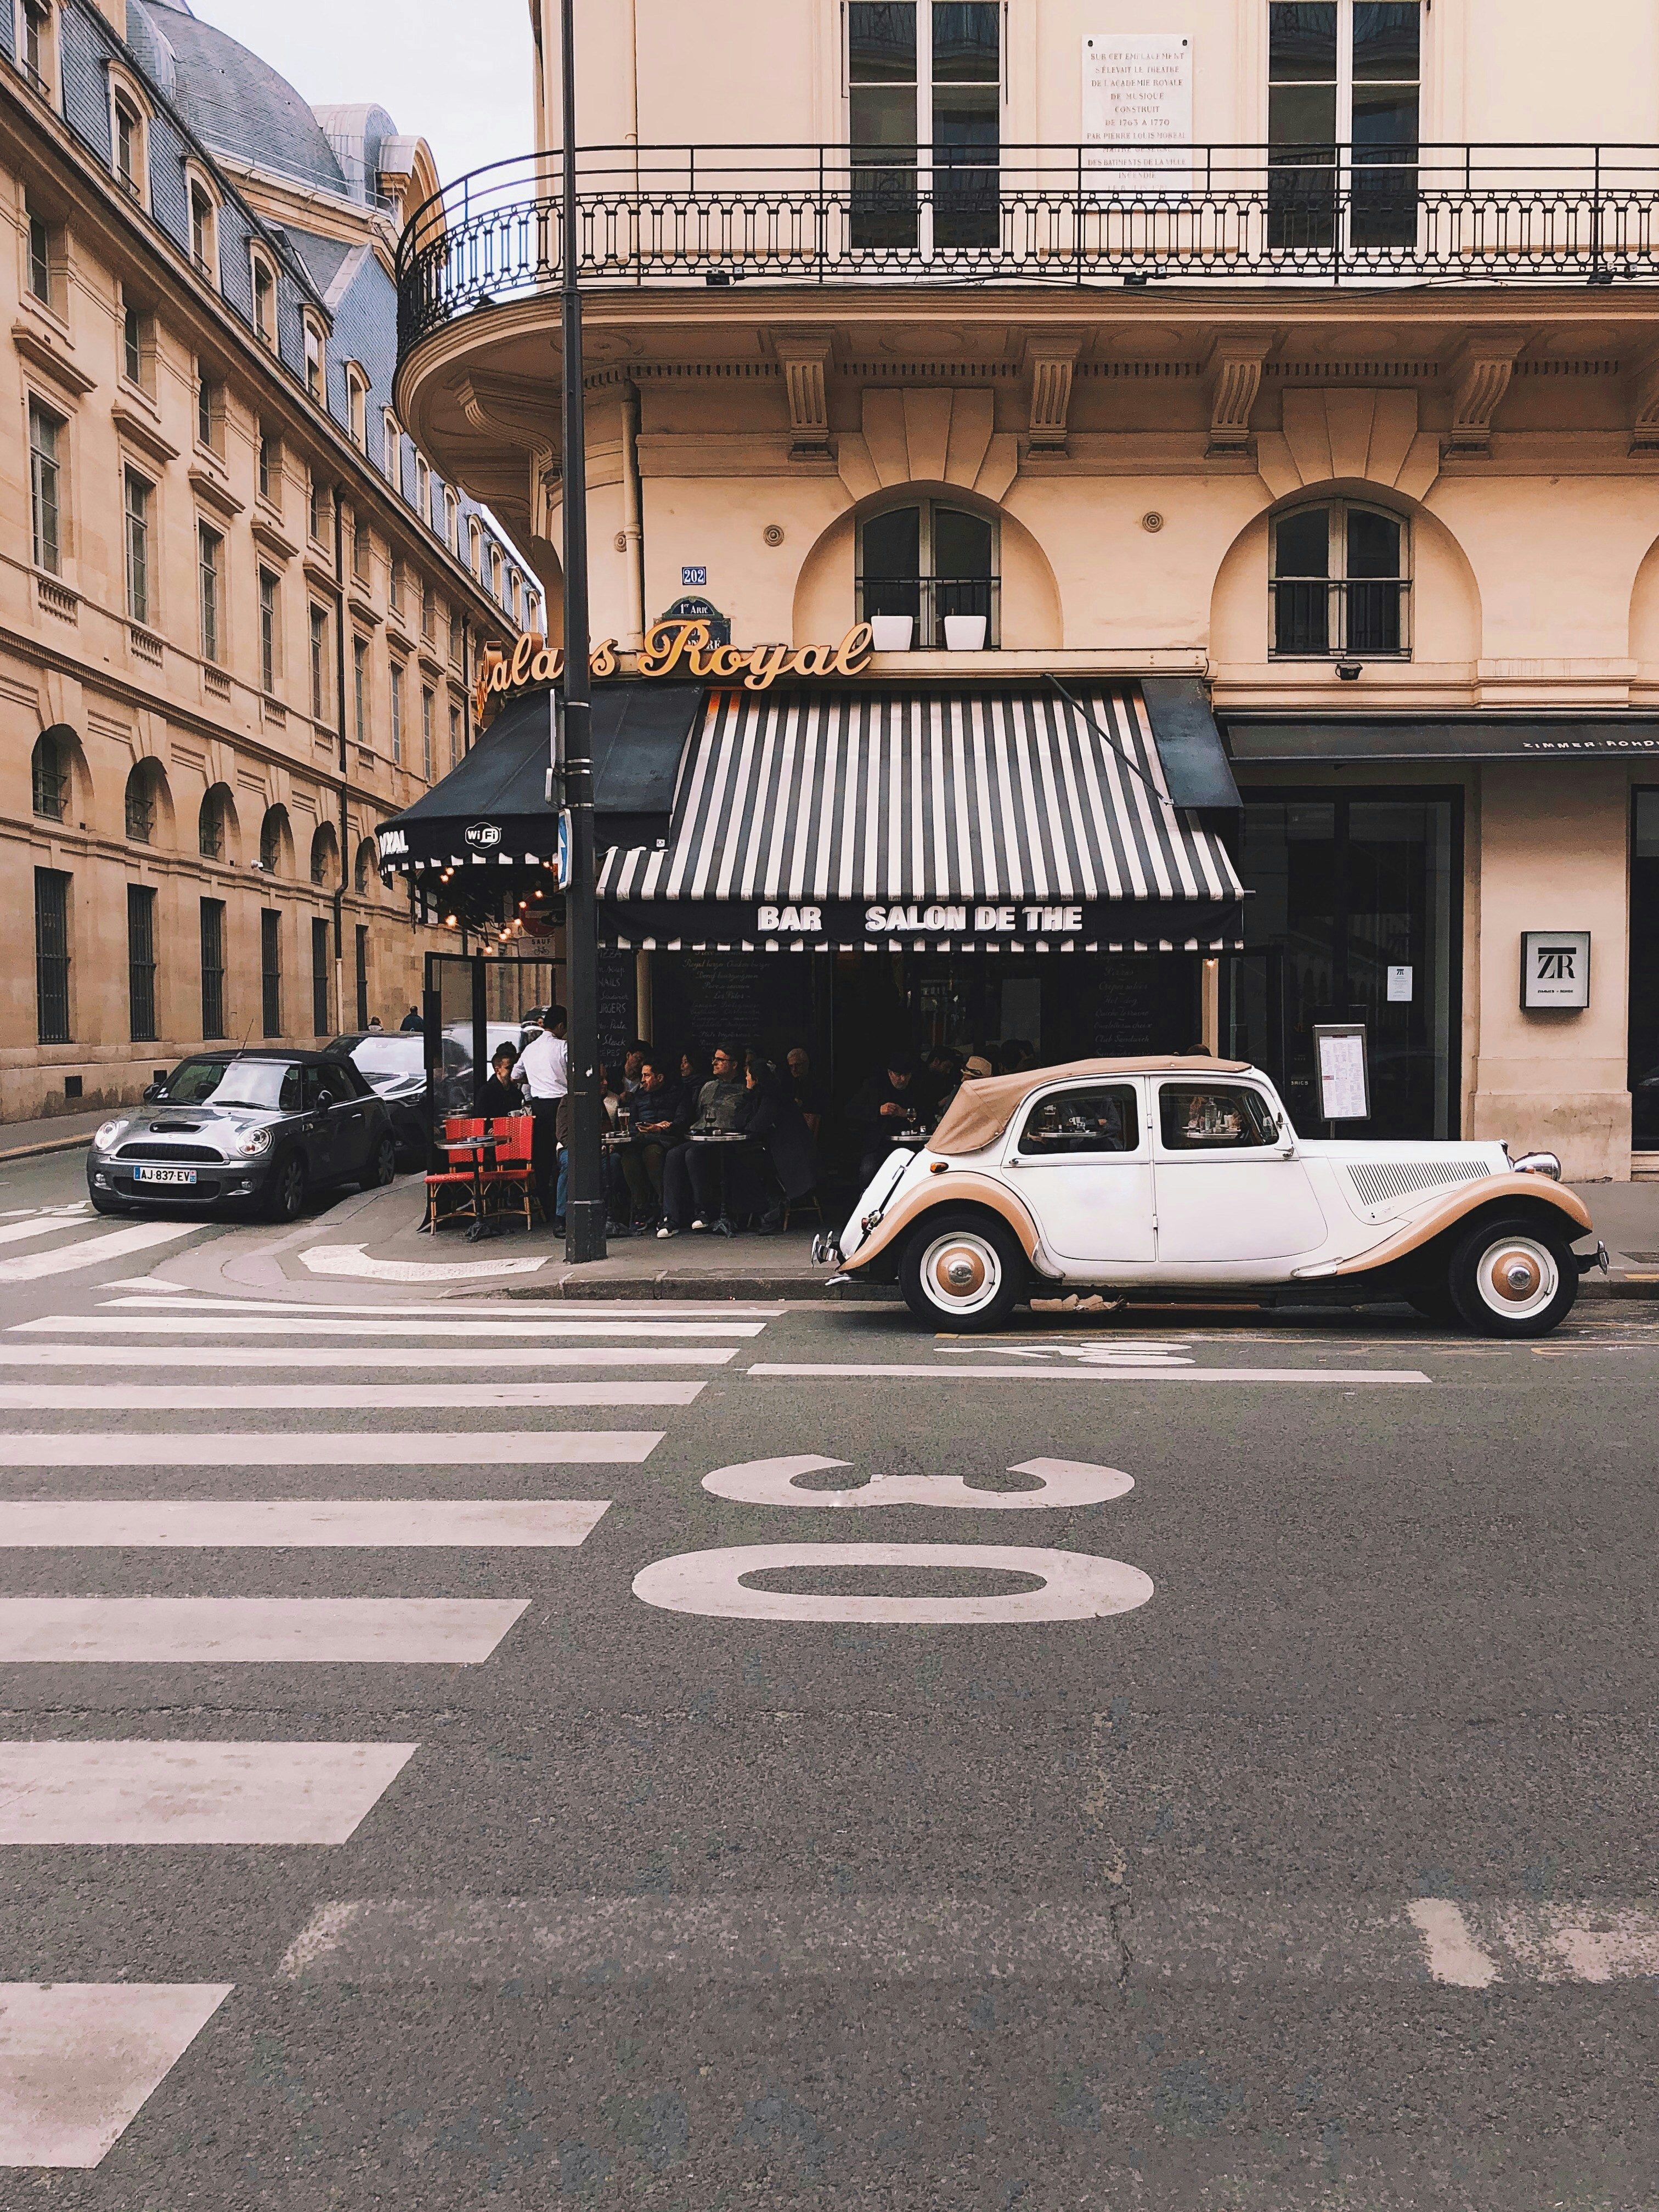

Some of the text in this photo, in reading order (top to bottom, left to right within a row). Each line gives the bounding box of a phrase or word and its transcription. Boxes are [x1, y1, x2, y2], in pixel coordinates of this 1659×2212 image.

[684, 569, 704, 583] 202
[640, 619, 874, 690] Royal
[758, 906, 1082, 931] BAR SALON DE THE
[600, 950, 622, 958] IZZA
[1537, 955, 1576, 979] ZR
[599, 1003, 627, 1014] URGERS
[141, 1169, 190, 1181] AJ-837-EV
[631, 1454, 1154, 1623] 30
